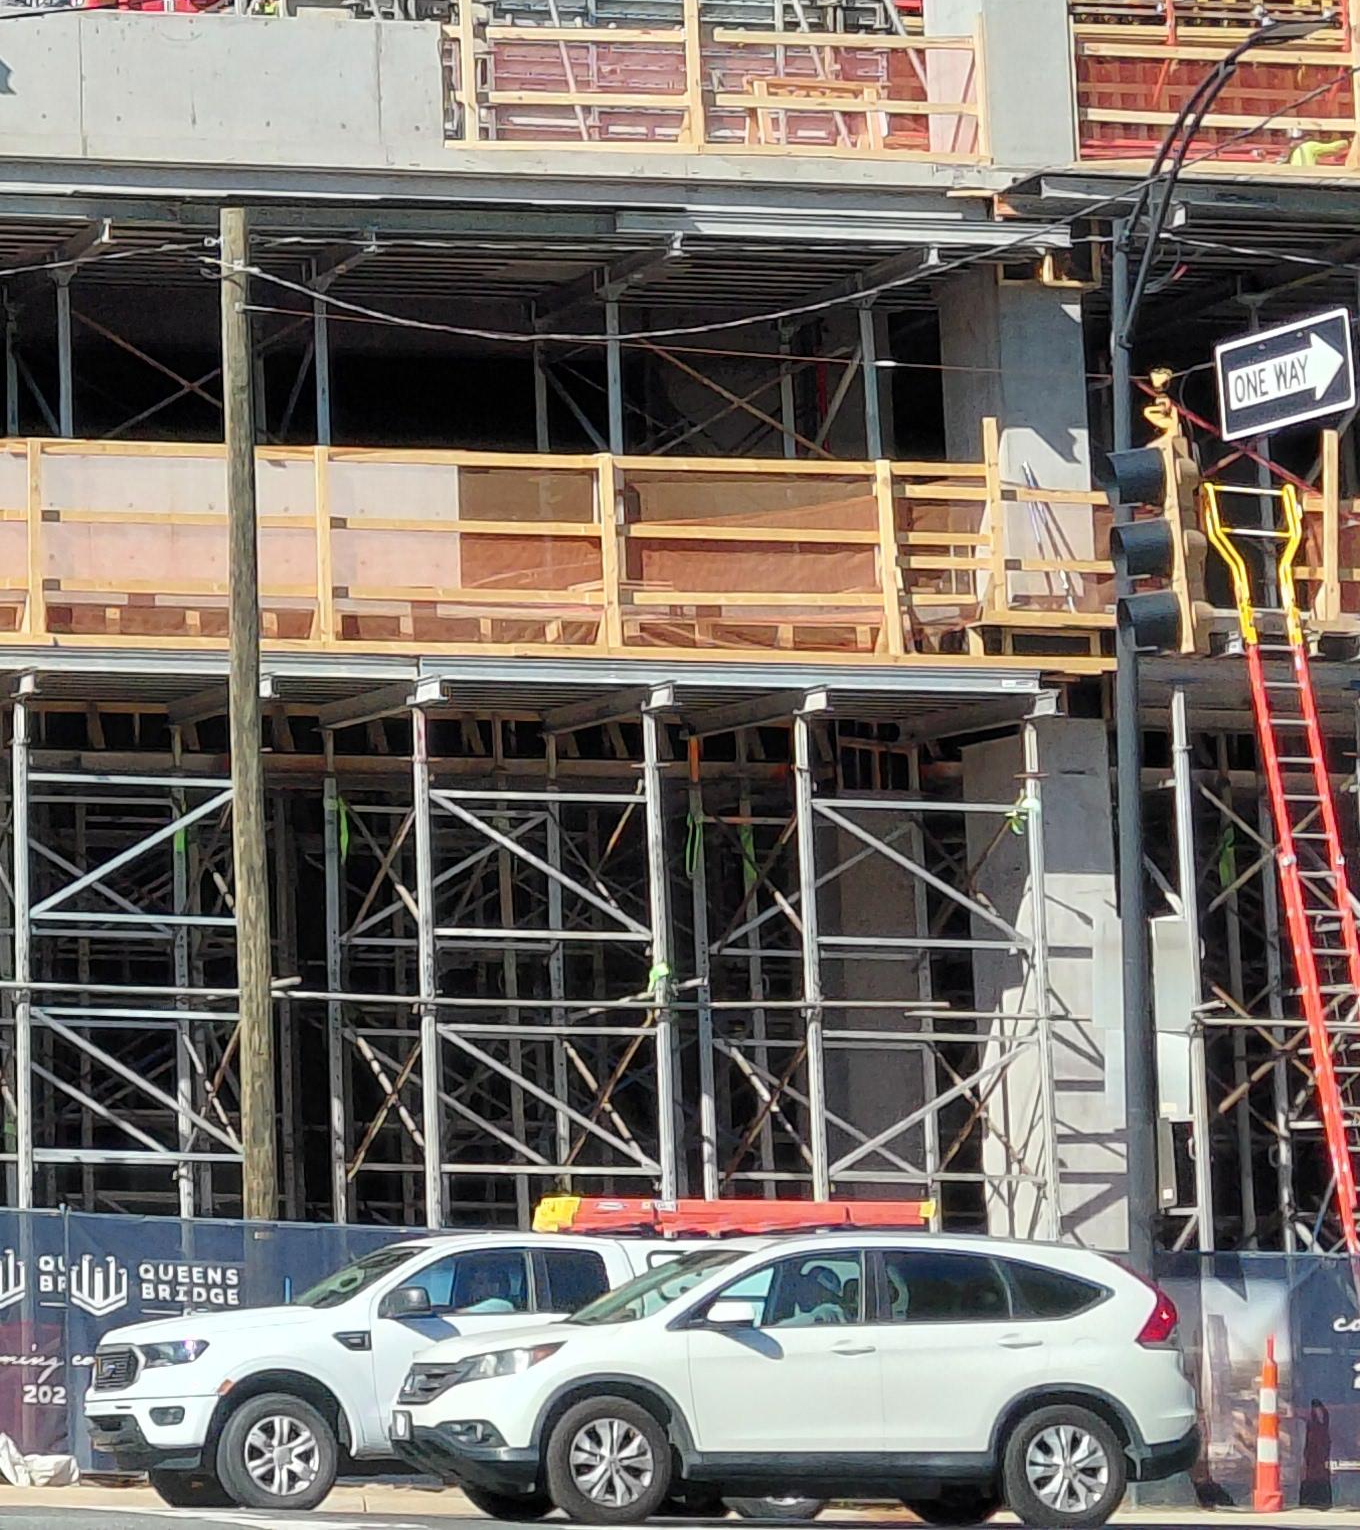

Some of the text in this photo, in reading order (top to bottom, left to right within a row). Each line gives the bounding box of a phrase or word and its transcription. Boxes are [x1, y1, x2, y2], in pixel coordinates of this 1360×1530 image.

[1234, 354, 1309, 403] ONE WAY
[138, 1263, 239, 1286] QUEENS
[141, 1283, 240, 1305] BRIDGE
[23, 1384, 67, 1405] 202
